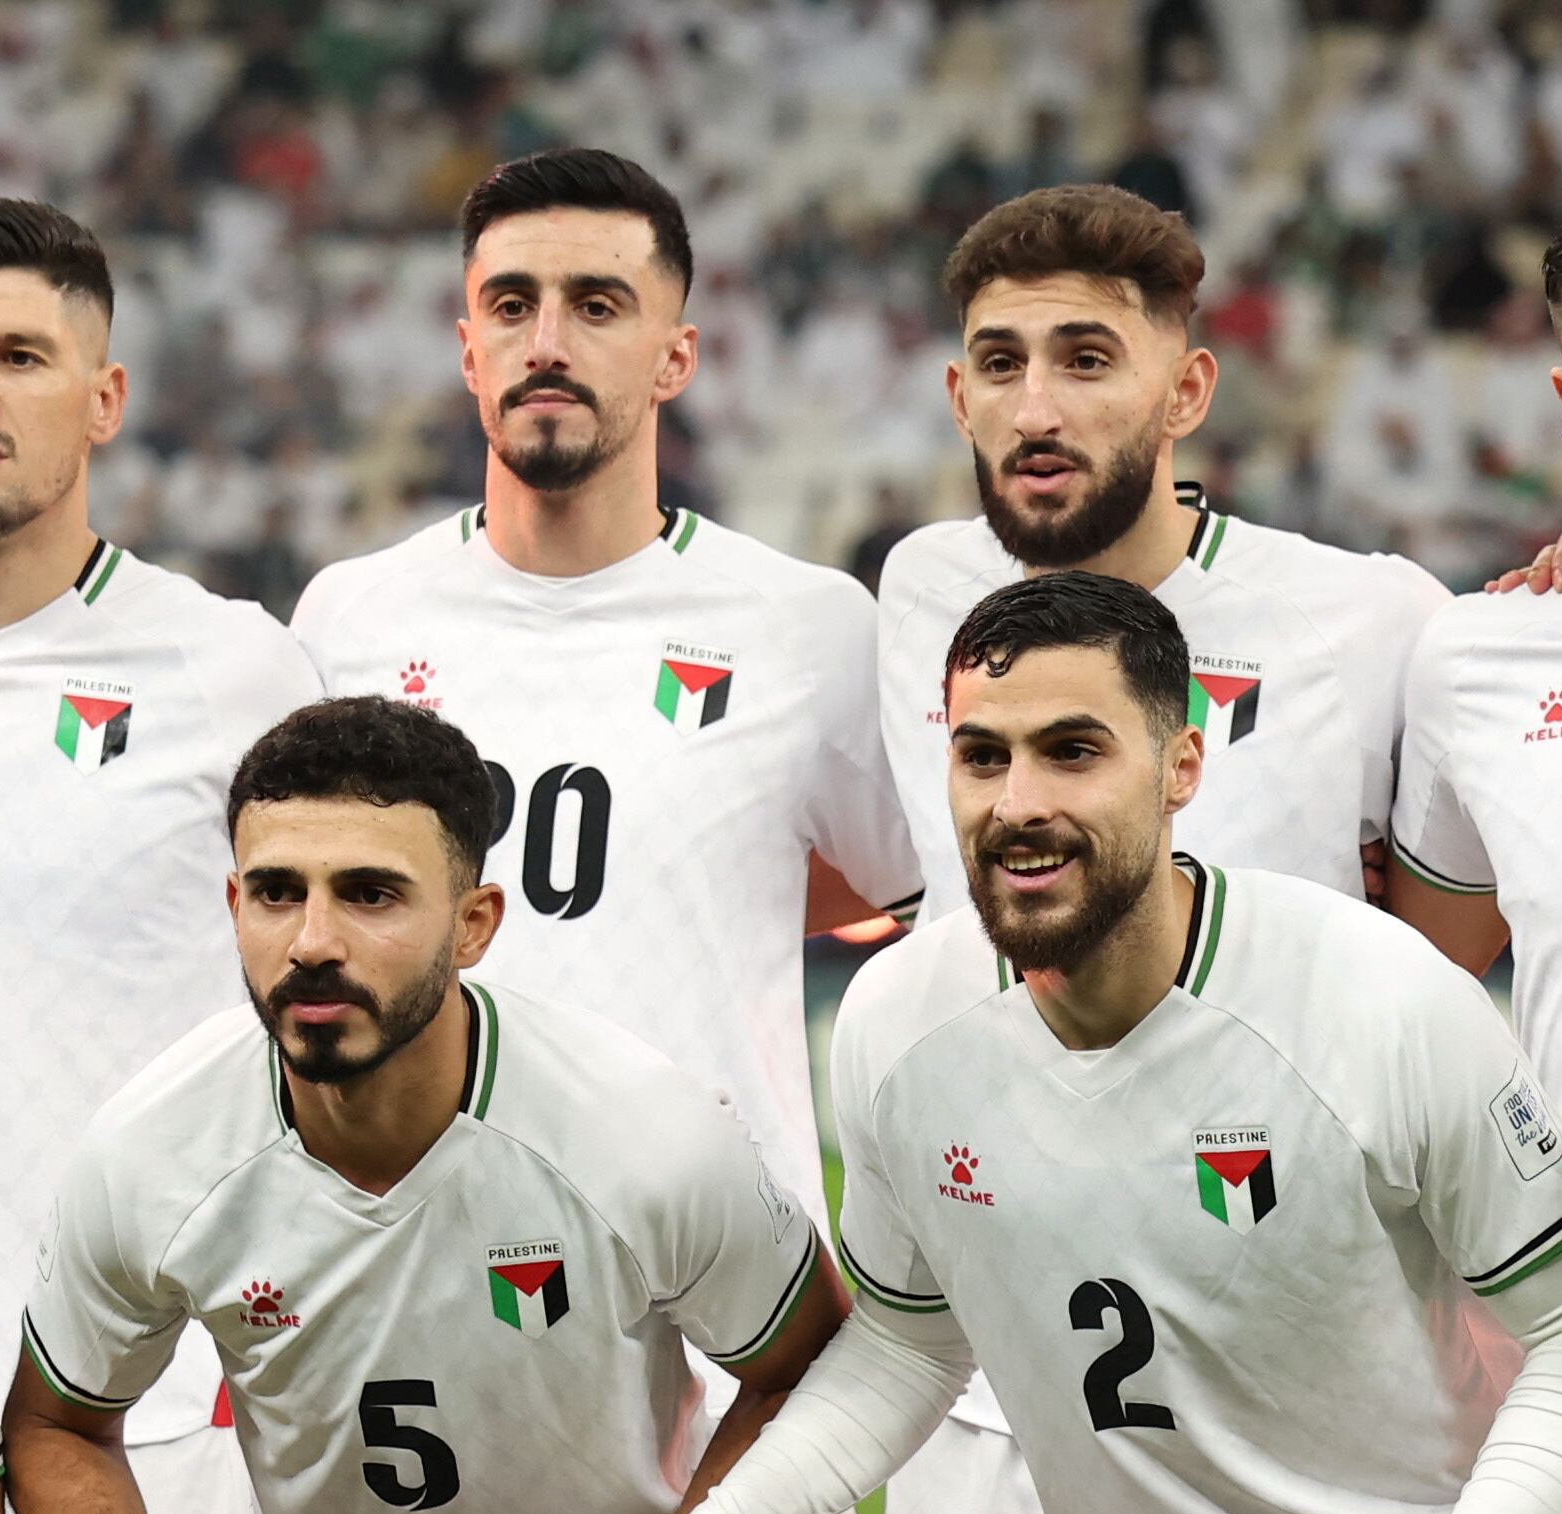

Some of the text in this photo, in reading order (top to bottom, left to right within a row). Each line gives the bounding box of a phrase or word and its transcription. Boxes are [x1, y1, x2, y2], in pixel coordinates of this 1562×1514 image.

[666, 643, 735, 663] PALESTINE
[1194, 655, 1263, 673] PALESTINE
[66, 678, 133, 695] PALESTINE
[484, 761, 612, 921] 0
[1195, 1131, 1268, 1145] PALESTINE
[938, 1183, 995, 1207] KELME
[488, 1243, 560, 1260] PALESTINE
[239, 1311, 301, 1328] KELME
[1068, 1278, 1177, 1432] 2
[357, 1378, 460, 1512] 5
